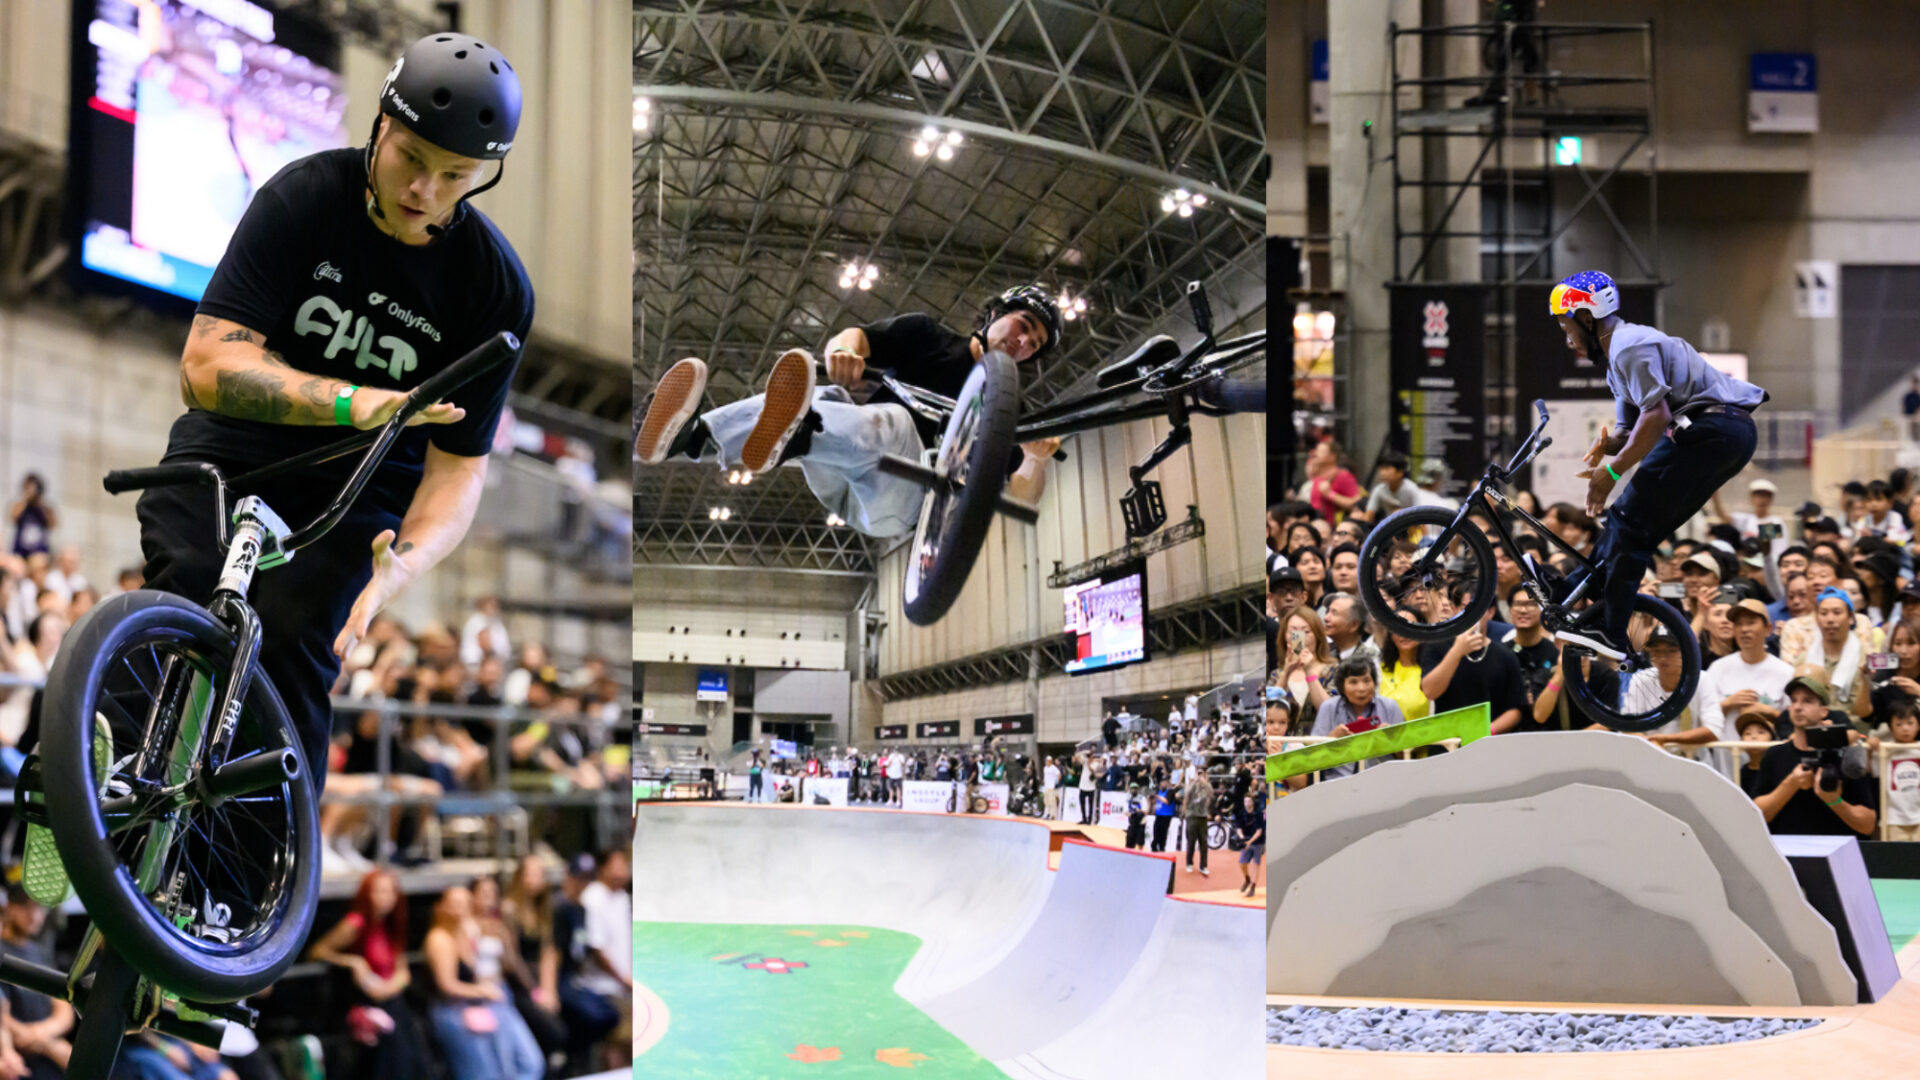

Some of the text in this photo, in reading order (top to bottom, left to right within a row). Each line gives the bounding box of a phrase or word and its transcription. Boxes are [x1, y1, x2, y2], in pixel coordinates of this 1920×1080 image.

[1792, 60, 1809, 87] 2
[392, 93, 420, 122] OnlyFans
[387, 301, 442, 343] OnlyFans
[906, 789, 947, 797] INSTYLE
